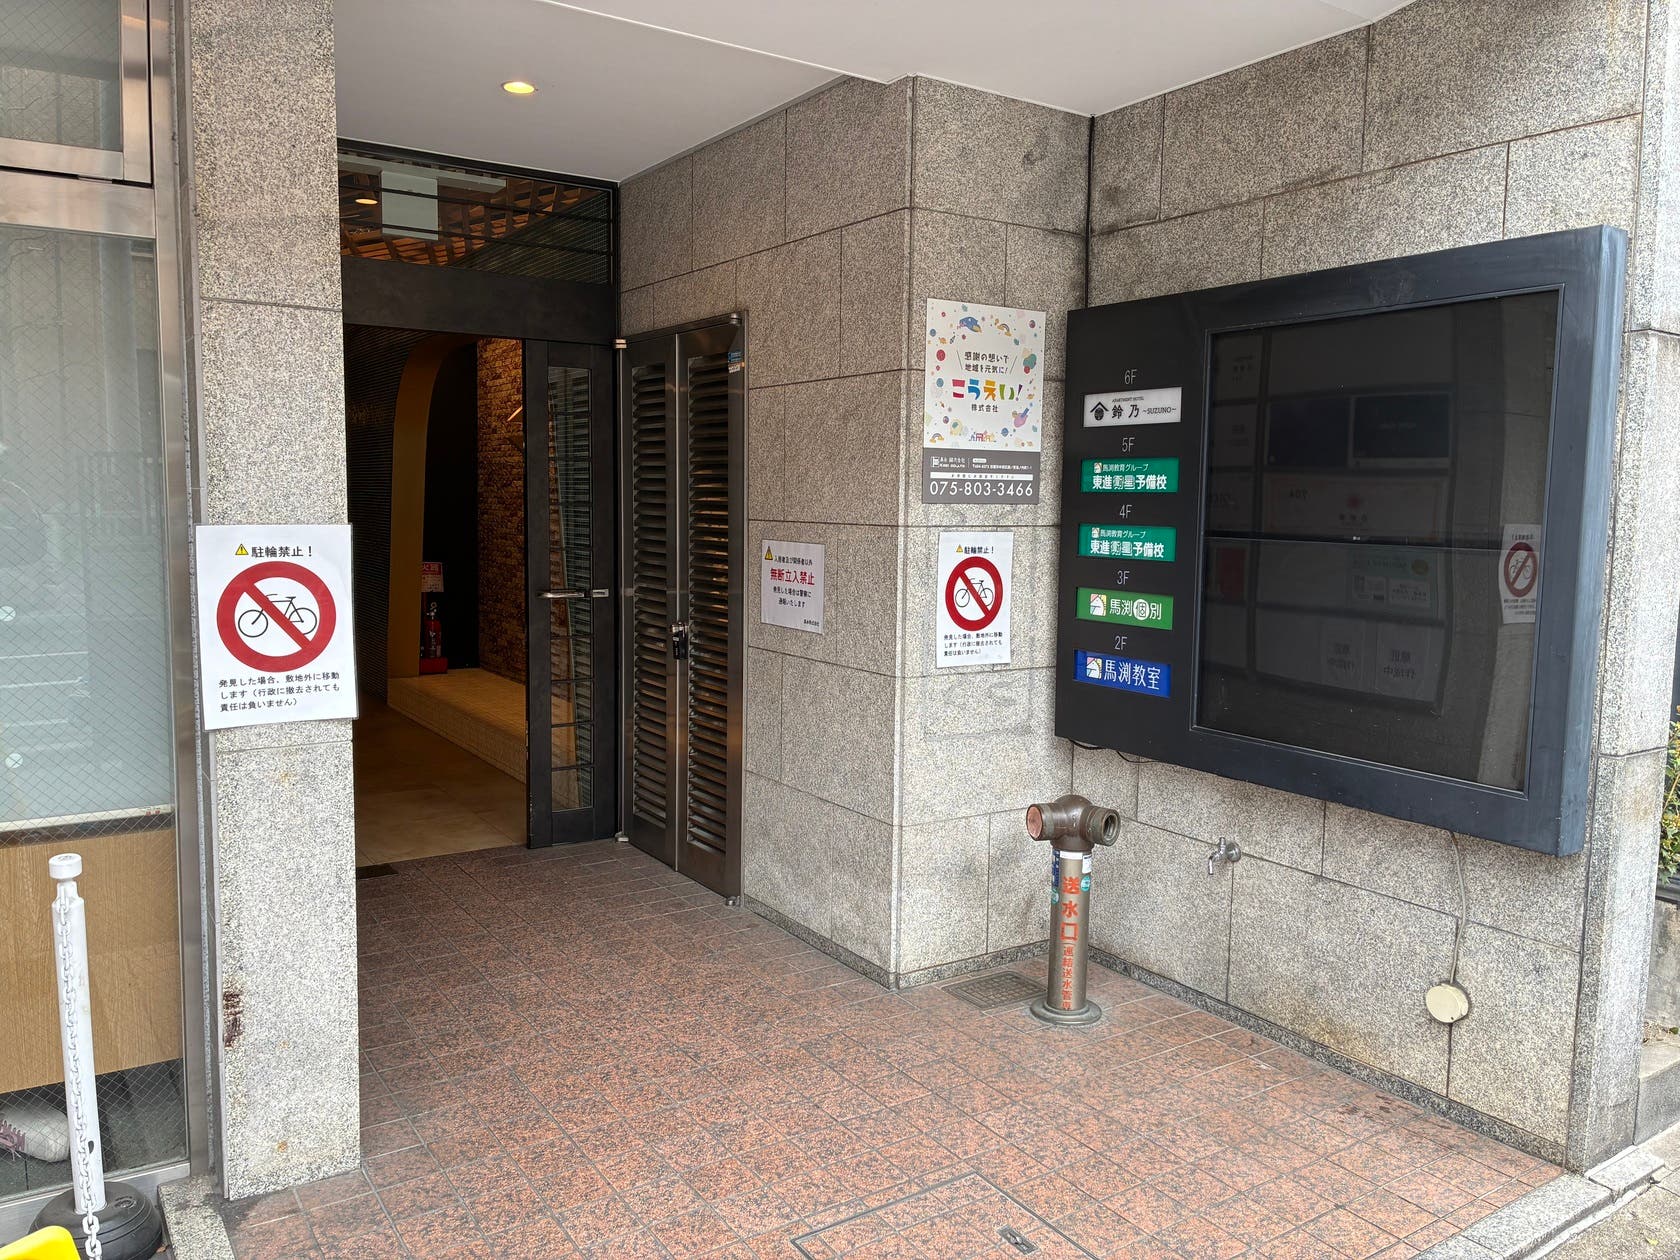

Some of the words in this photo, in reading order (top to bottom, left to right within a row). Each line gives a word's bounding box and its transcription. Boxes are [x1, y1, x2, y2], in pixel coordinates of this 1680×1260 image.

[964, 351, 1010, 363] 感謝の想いで
[1124, 369, 1137, 385] 6F
[952, 378, 1023, 402] こうえい!
[971, 403, 999, 413] 株式会社
[1122, 437, 1135, 452] 5F
[929, 481, 1034, 497] 075-803-3466
[1092, 474, 1167, 490] 東進衛星予備校
[1119, 504, 1132, 519] 4F
[251, 545, 313, 558] 駐輪禁止!
[964, 545, 994, 555] 駐輪禁止!
[1090, 539, 1165, 558] 東進衛星予備校
[771, 568, 814, 585] 無断立入禁止
[1116, 570, 1130, 585] 3F
[1109, 597, 1162, 621] 馬渕個別
[1114, 635, 1128, 650] 2F
[219, 673, 340, 688] 発見した場合、敷地外に移動
[1103, 659, 1161, 690] 馬渕教室
[220, 683, 340, 700] します（行政に撤去されても
[219, 698, 298, 712] 責任は負いません）
[1060, 877, 1080, 940] 送水口
